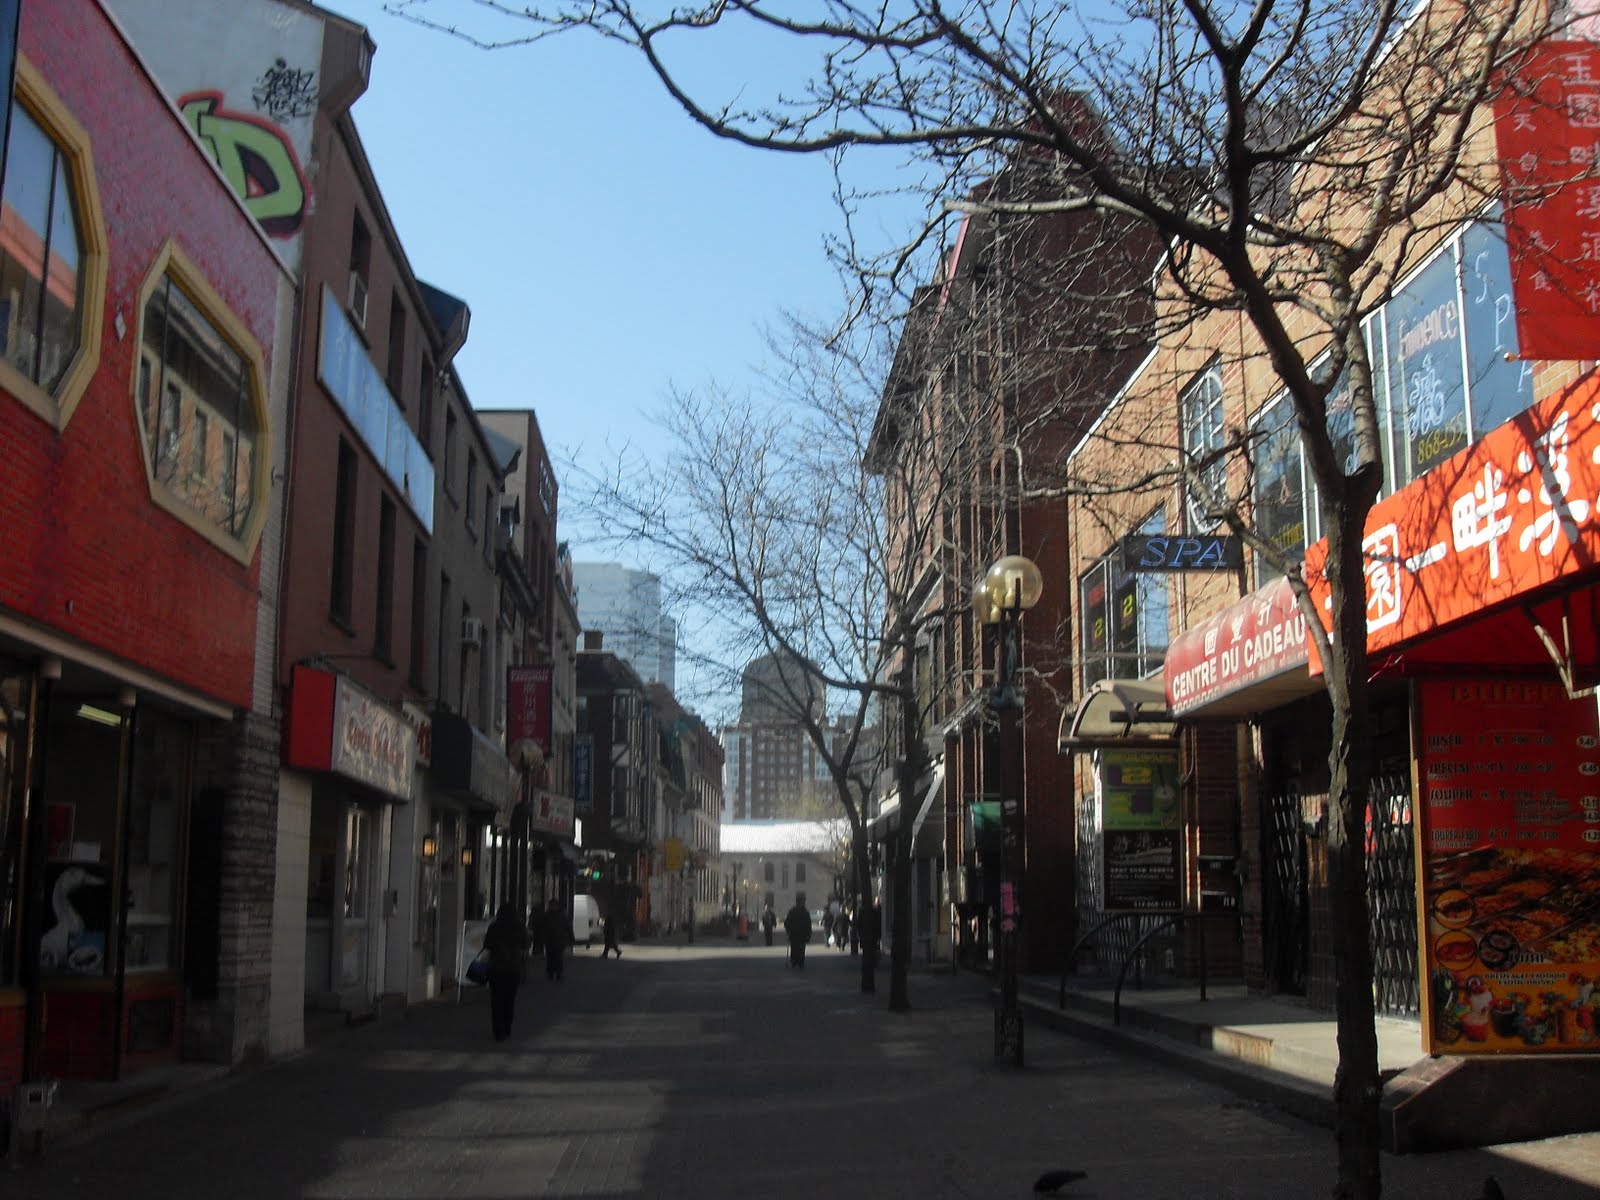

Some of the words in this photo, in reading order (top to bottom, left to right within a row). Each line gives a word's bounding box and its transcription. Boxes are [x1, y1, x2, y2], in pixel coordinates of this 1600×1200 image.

[1140, 536, 1228, 568] SPA
[1172, 656, 1217, 702] CENTRE
[1221, 646, 1239, 678] DU
[1244, 612, 1306, 669] CADEAU
